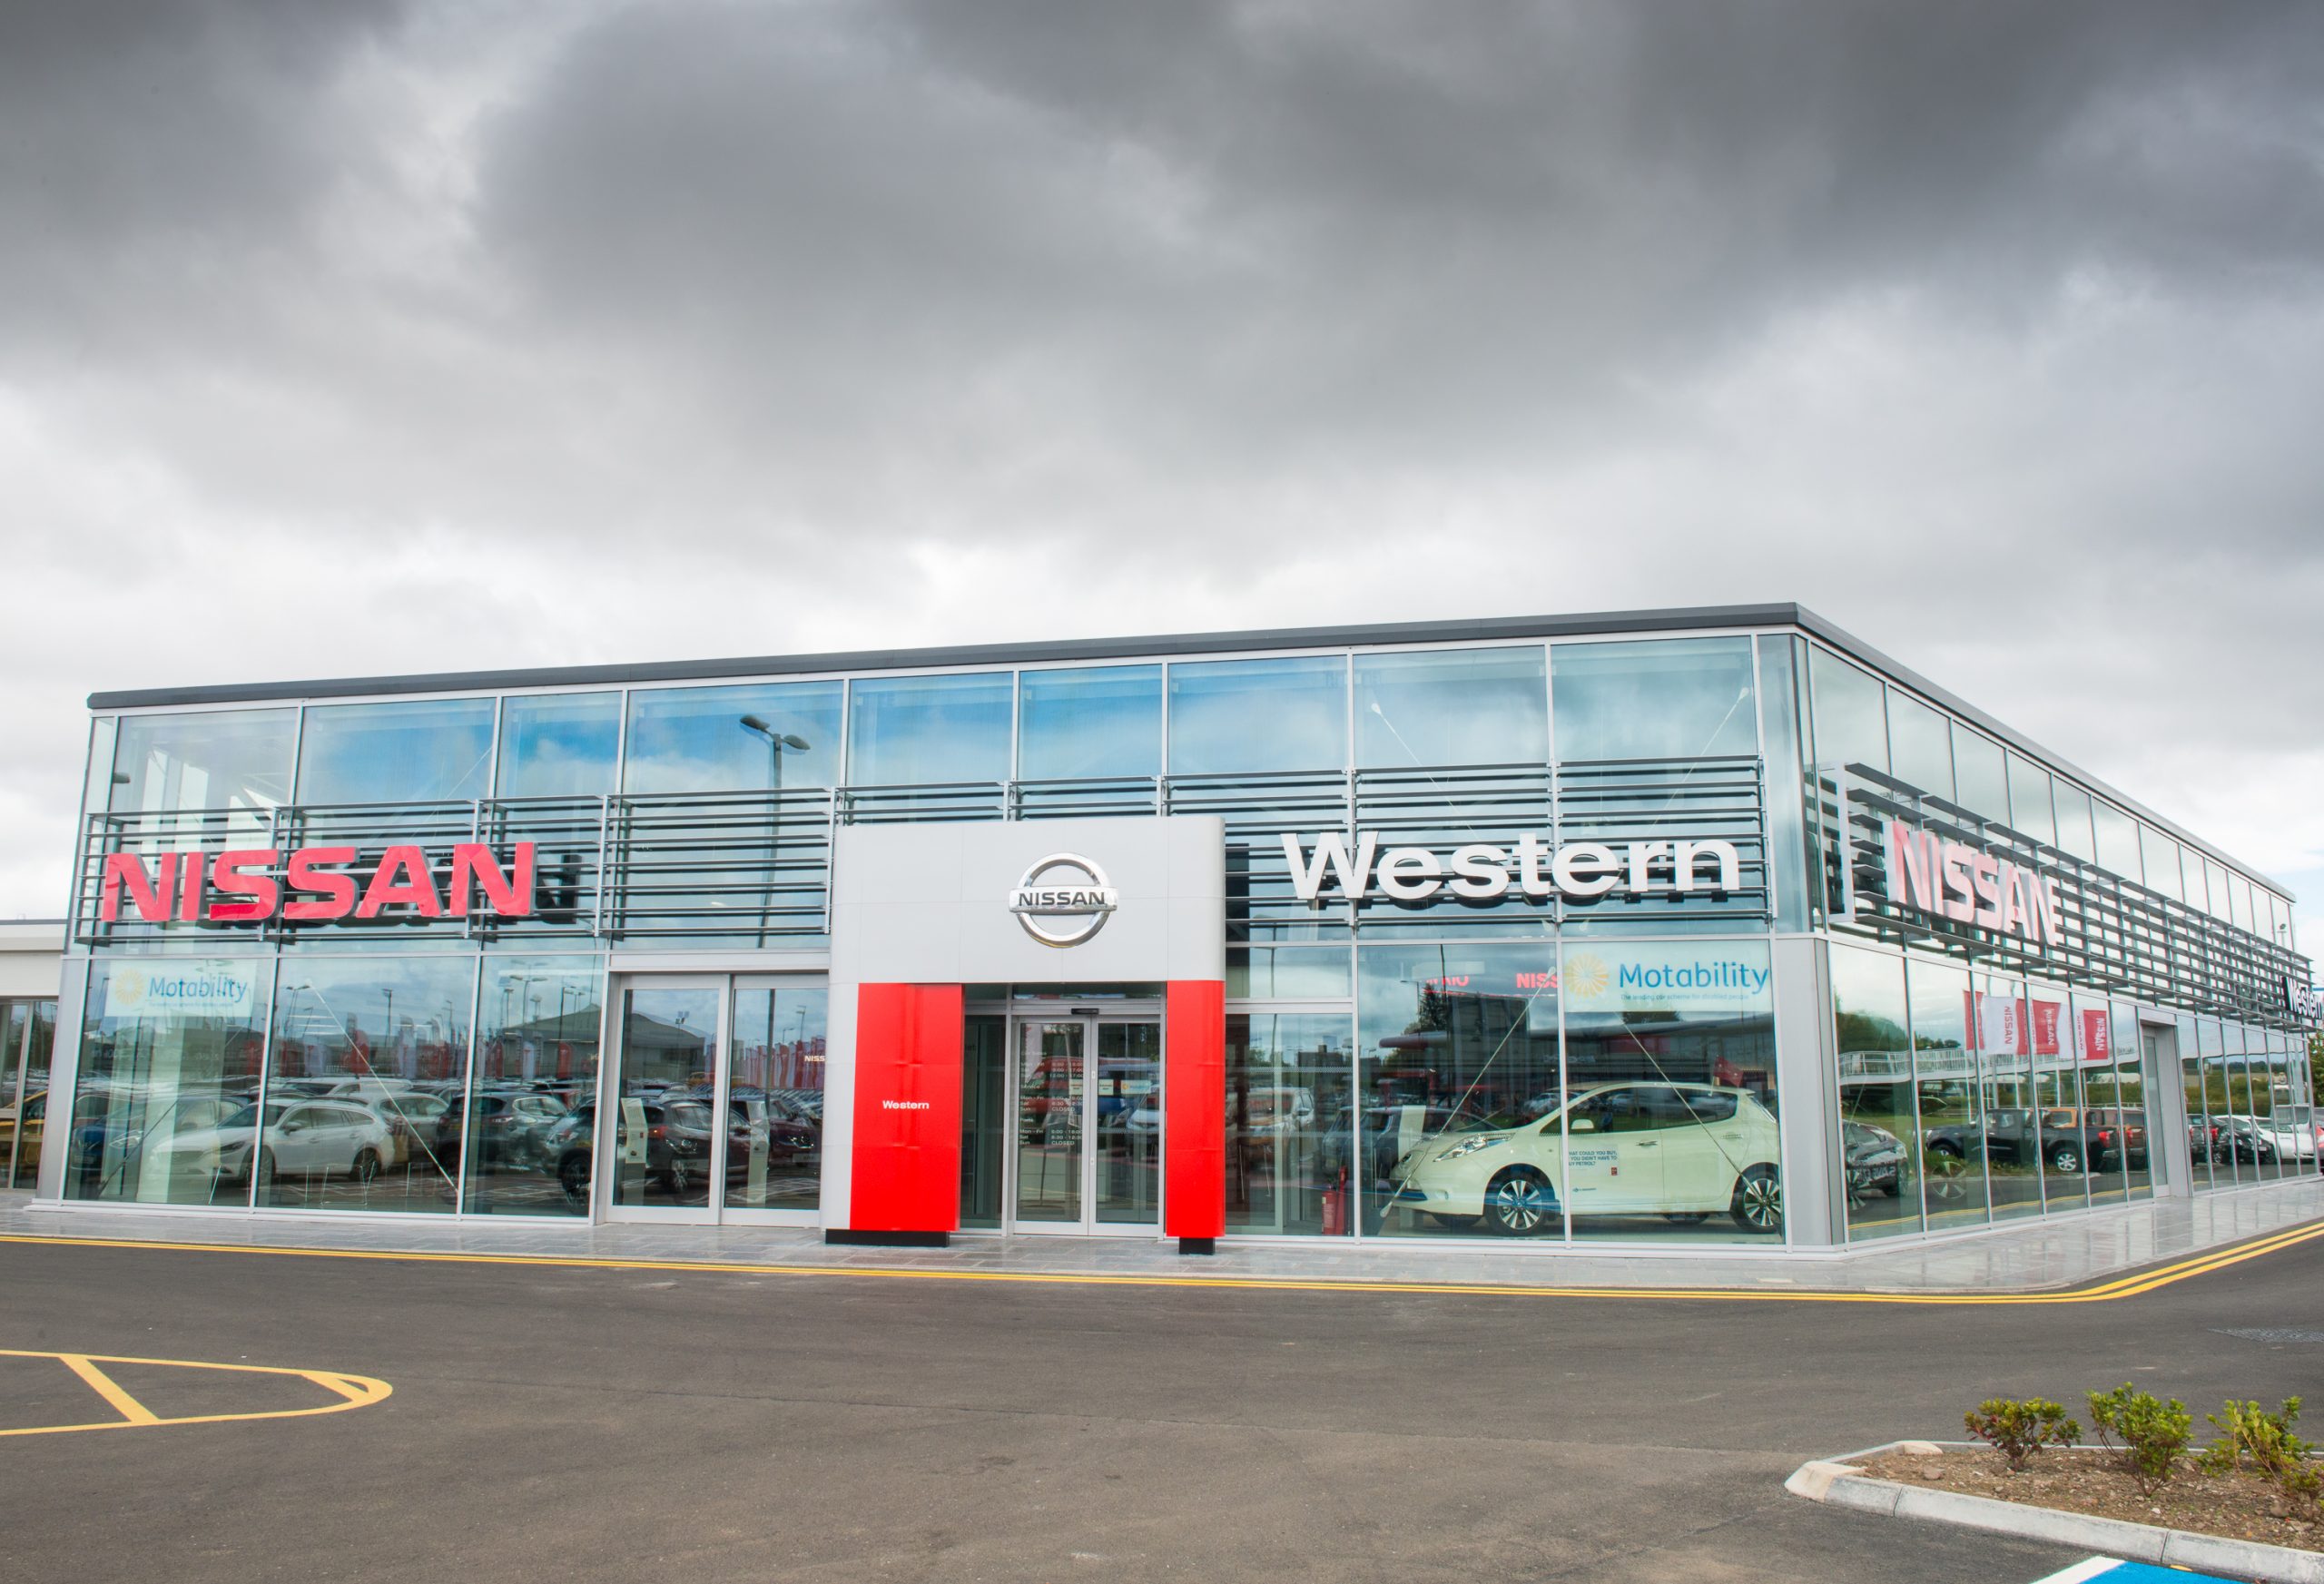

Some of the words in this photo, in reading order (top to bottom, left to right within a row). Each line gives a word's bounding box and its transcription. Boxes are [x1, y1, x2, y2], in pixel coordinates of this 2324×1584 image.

[101, 841, 535, 921] NISSAN
[1281, 831, 1739, 900] Western
[1019, 891, 1105, 906] NISSAN
[1886, 821, 2057, 947] NISSAN
[149, 976, 247, 1003] Motability
[1619, 961, 1768, 995] Motability
[2287, 977, 2321, 1019] Western
[2004, 1006, 2013, 1044] NISSAN
[2094, 1018, 2105, 1051] NISSAN
[881, 1100, 930, 1109] Western
